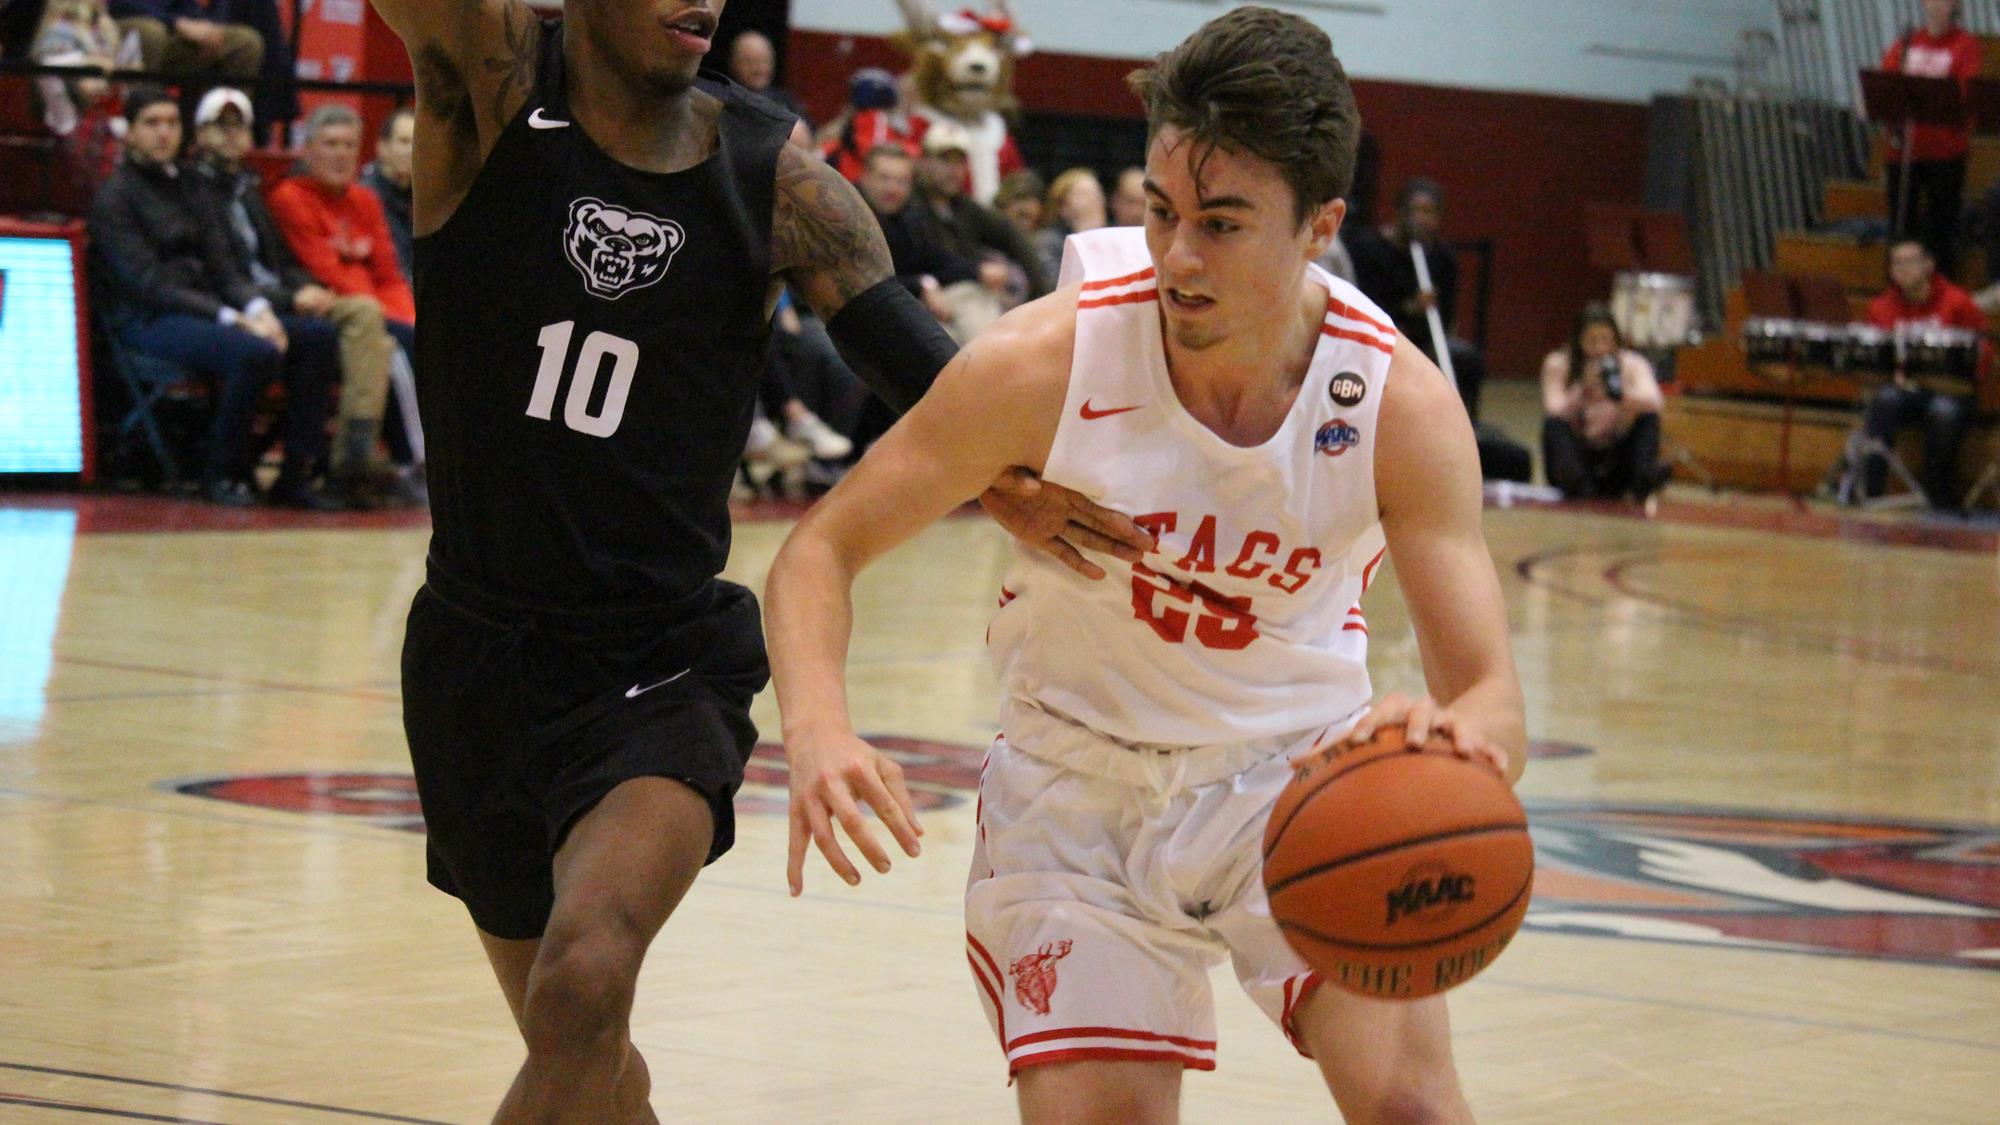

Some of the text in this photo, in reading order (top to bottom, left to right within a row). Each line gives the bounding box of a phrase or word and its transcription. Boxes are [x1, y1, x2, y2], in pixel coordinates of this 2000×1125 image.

[525, 320, 639, 438] 10
[1332, 379, 1363, 398] GBM
[1314, 426, 1360, 455] MAAC
[1133, 511, 1321, 594] TAGS
[1386, 874, 1475, 927] MAAC
[1336, 961, 1413, 995] THE
